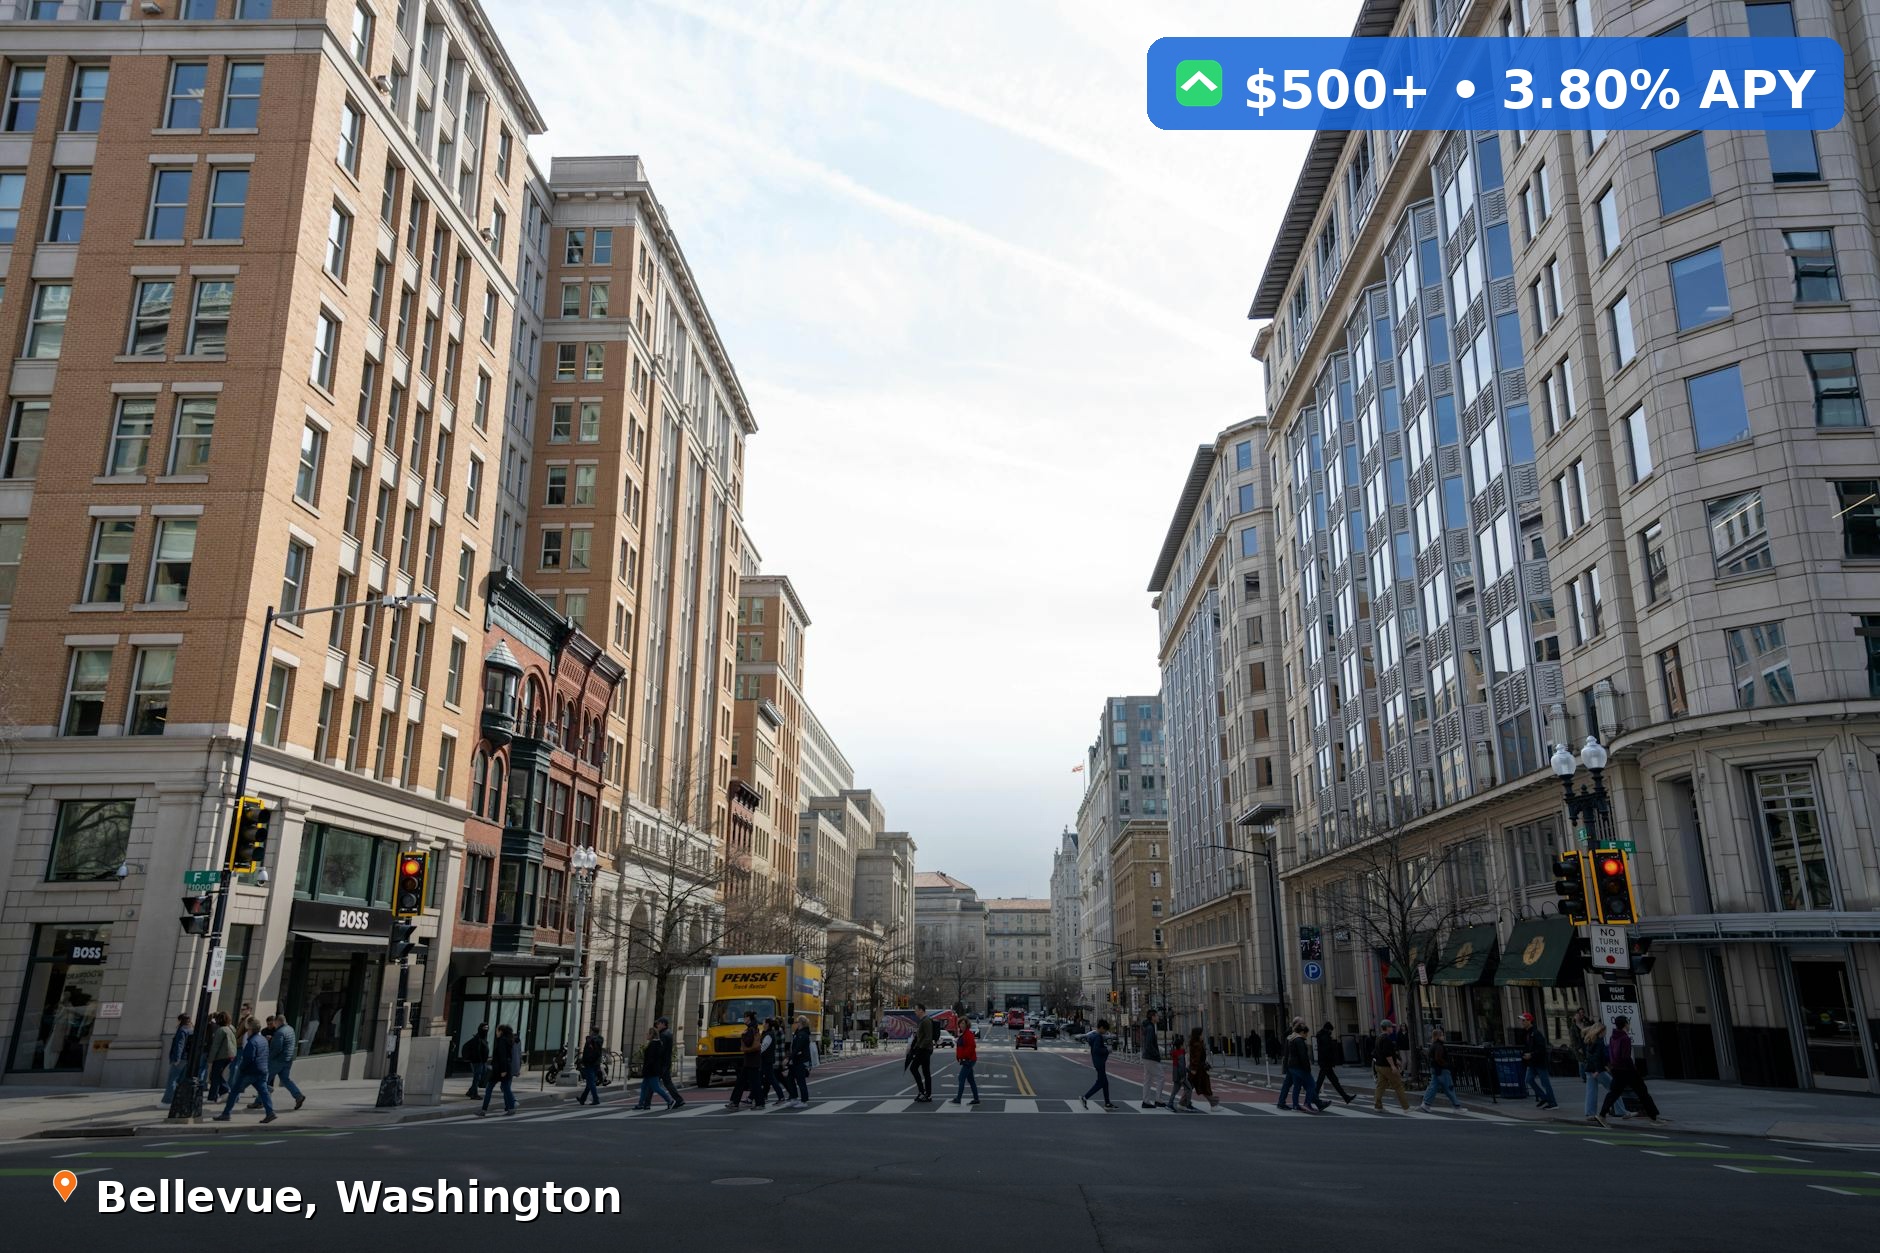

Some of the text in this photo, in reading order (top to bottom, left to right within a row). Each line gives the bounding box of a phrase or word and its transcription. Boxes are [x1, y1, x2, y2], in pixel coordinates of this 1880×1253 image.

[193, 872, 202, 883] F
[338, 909, 370, 931] BOSS
[1600, 928, 1616, 937] NO
[1599, 938, 1620, 946] TURN
[72, 946, 102, 959] BOSS
[1609, 946, 1625, 955] RED
[1308, 964, 1319, 978] P
[722, 972, 780, 982] PENSKE
[1608, 986, 1625, 994] RIGHT
[1606, 1004, 1634, 1015] BUSES
[1610, 1016, 1632, 1025] OY
